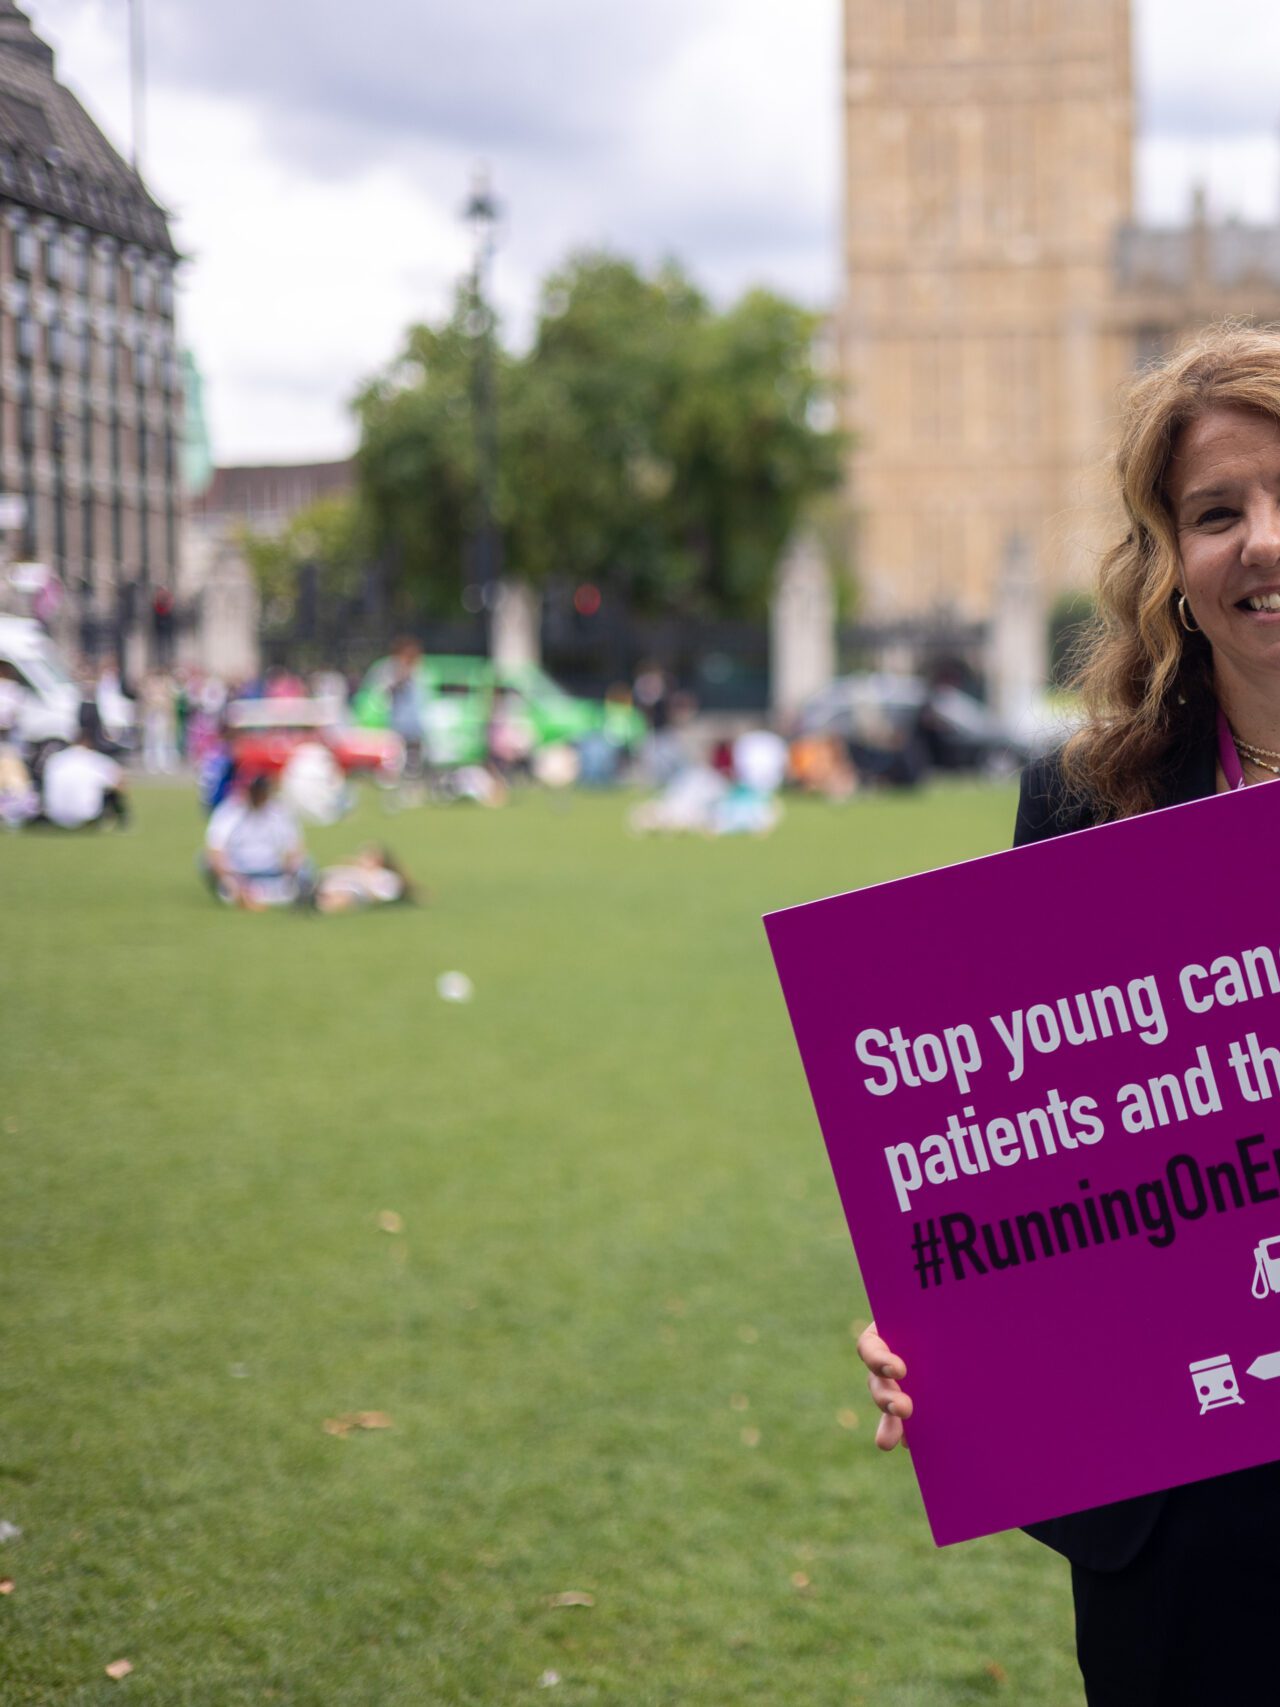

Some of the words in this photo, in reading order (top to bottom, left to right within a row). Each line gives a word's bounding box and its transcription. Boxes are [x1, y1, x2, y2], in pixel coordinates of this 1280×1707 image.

[854, 1023, 983, 1097] Stop
[989, 974, 1169, 1082] young
[883, 1088, 1105, 1213] patients
[1116, 1045, 1223, 1134] and
